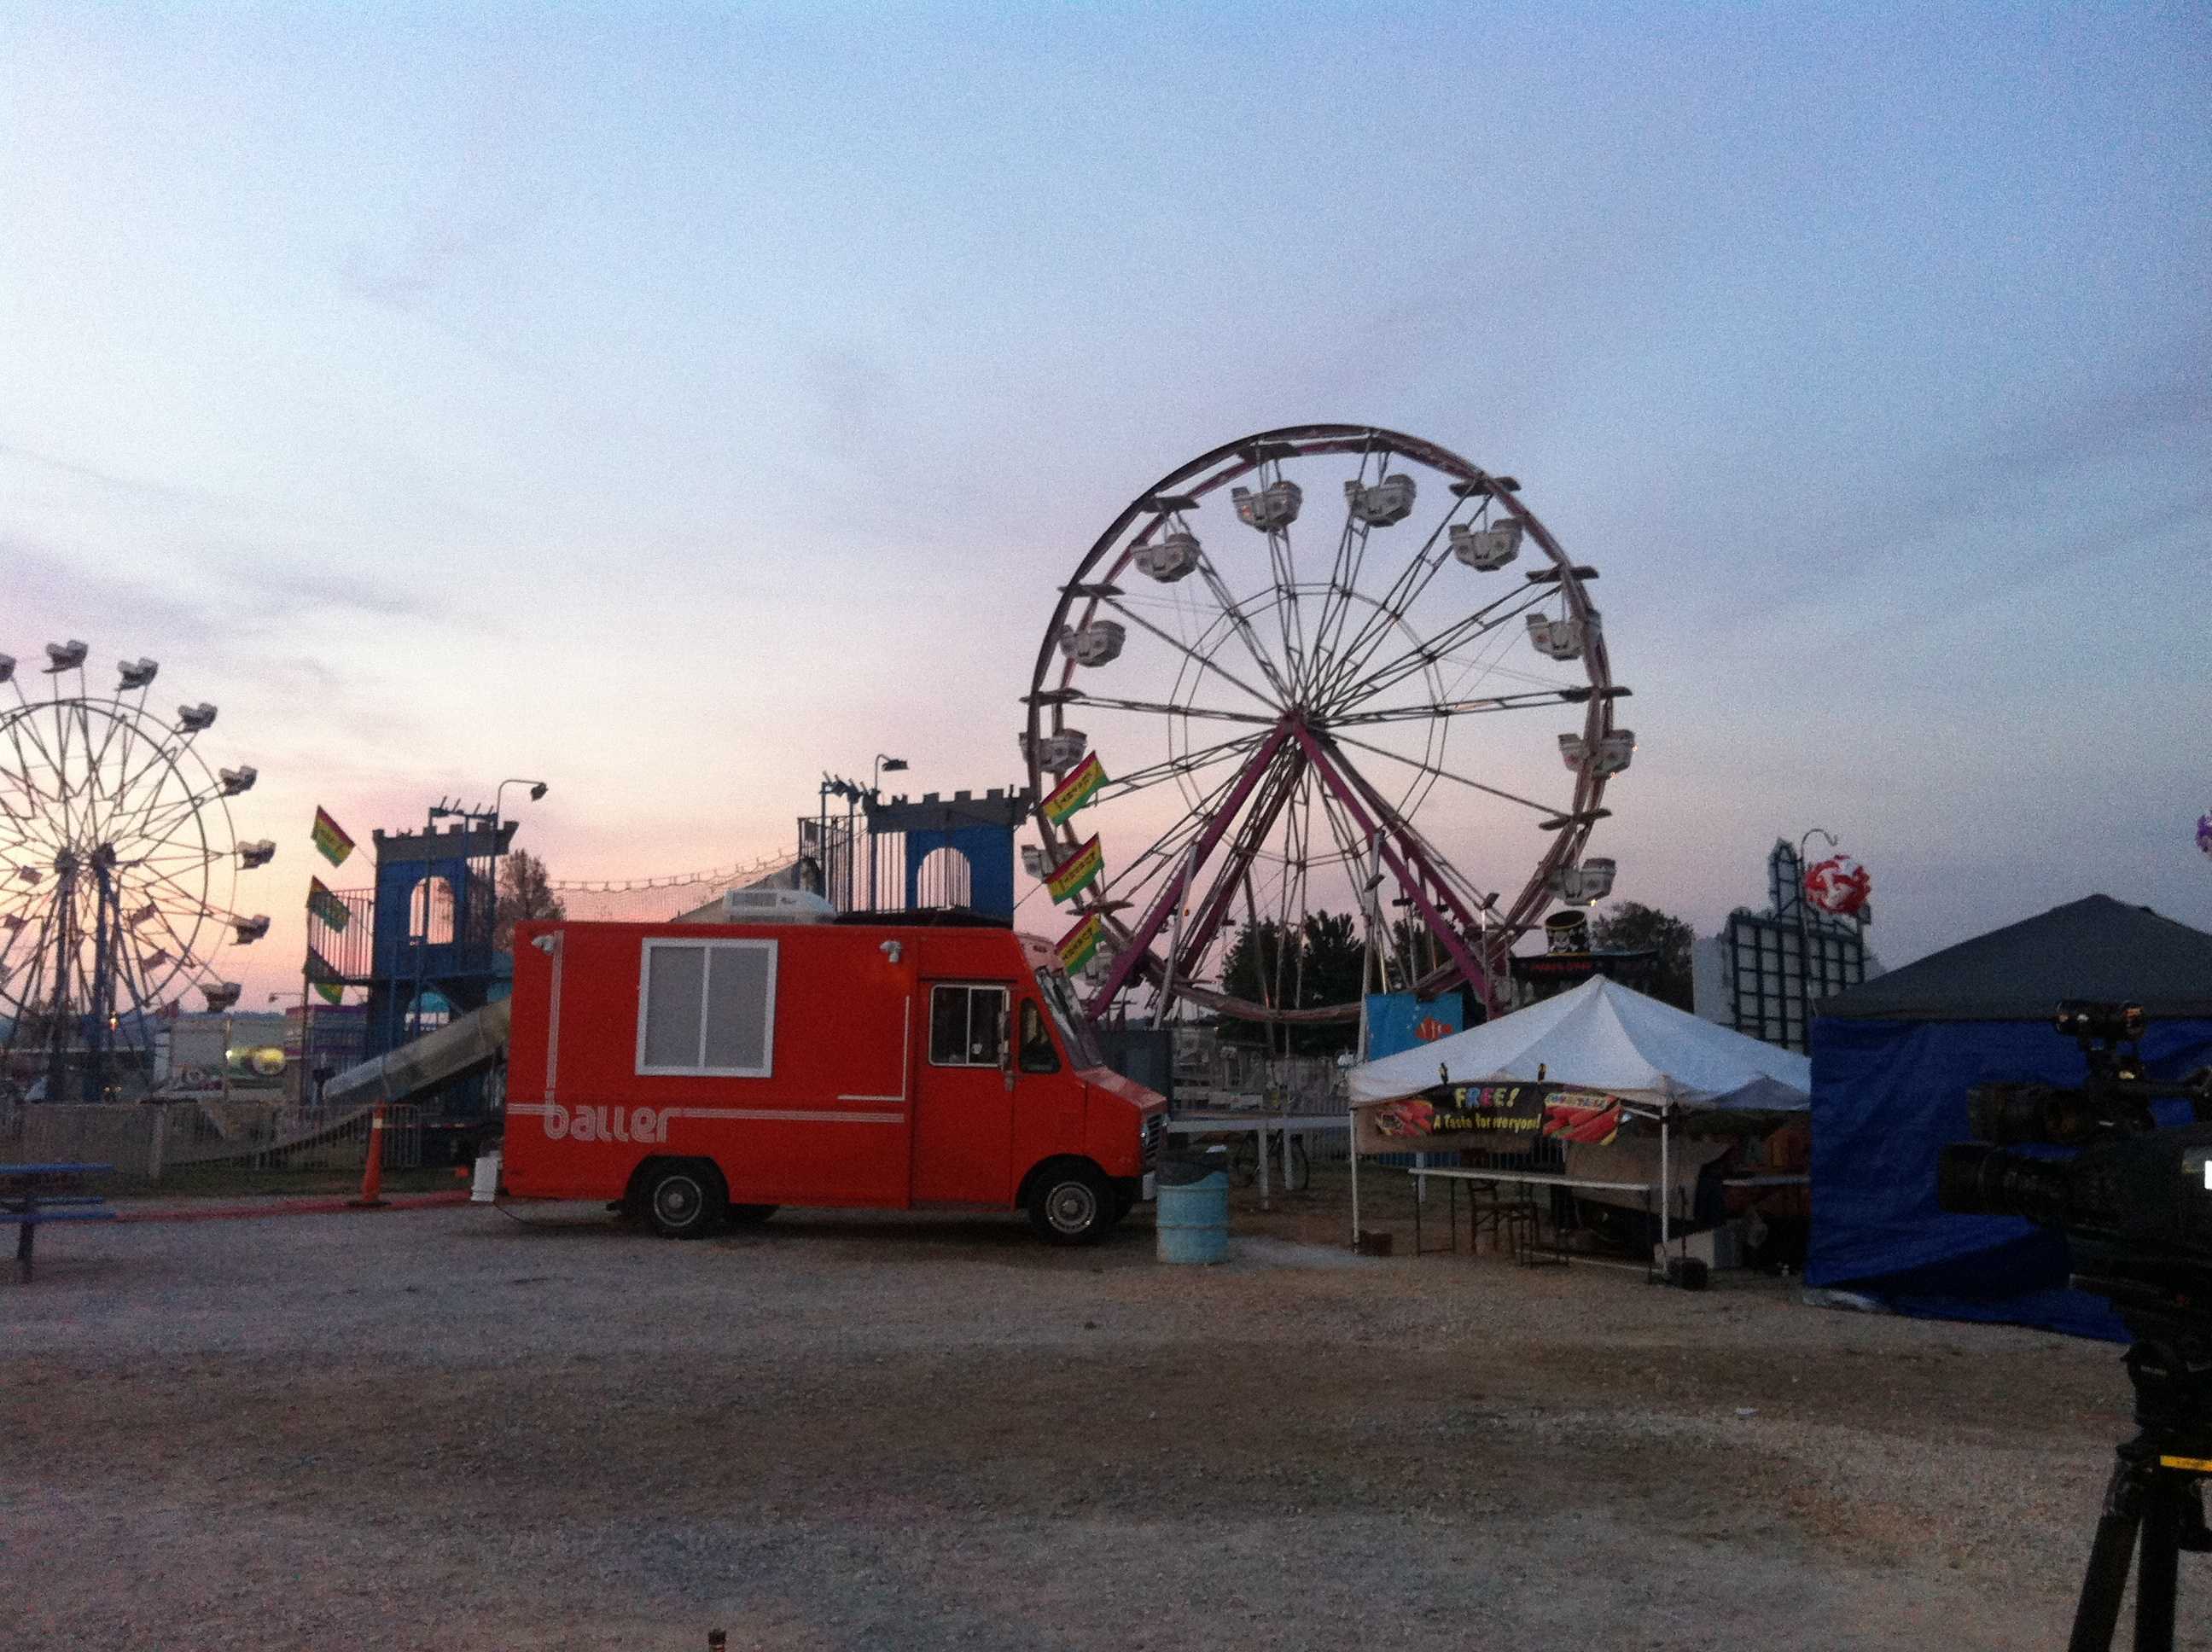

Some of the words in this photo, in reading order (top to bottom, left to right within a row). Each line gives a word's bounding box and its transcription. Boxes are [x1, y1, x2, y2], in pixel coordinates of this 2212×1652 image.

[1454, 1087, 1520, 1108] FREE!
[544, 1102, 679, 1143] baller
[1433, 1114, 1441, 1131] A
[1444, 1114, 1473, 1130] Taste
[1475, 1113, 1491, 1129] for
